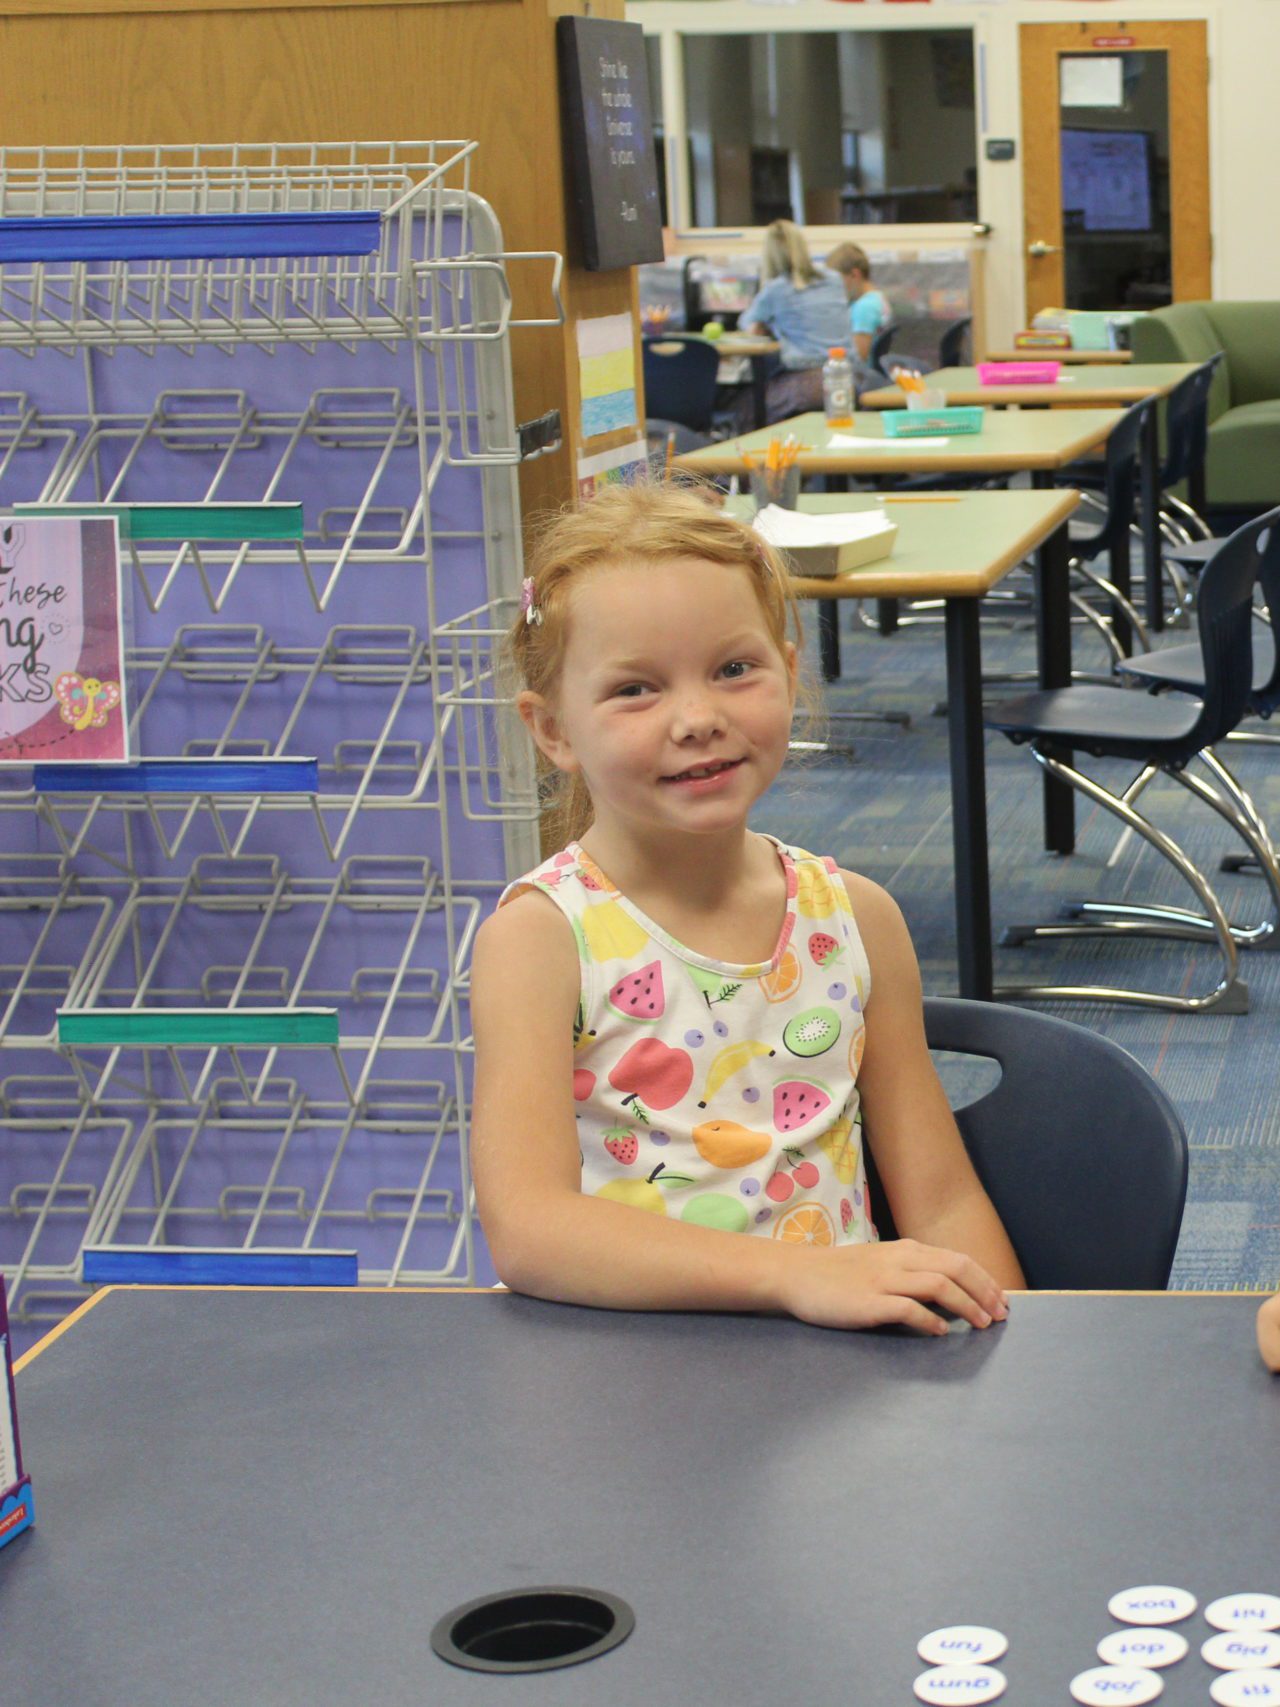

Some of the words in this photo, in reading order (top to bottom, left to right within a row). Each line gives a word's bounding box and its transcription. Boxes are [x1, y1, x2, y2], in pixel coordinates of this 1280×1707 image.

[1127, 1599, 1176, 1609] box
[940, 1641, 983, 1653] fun
[1225, 1643, 1268, 1656] pig
[929, 1678, 990, 1688] gum
[1093, 1680, 1141, 1693] job
